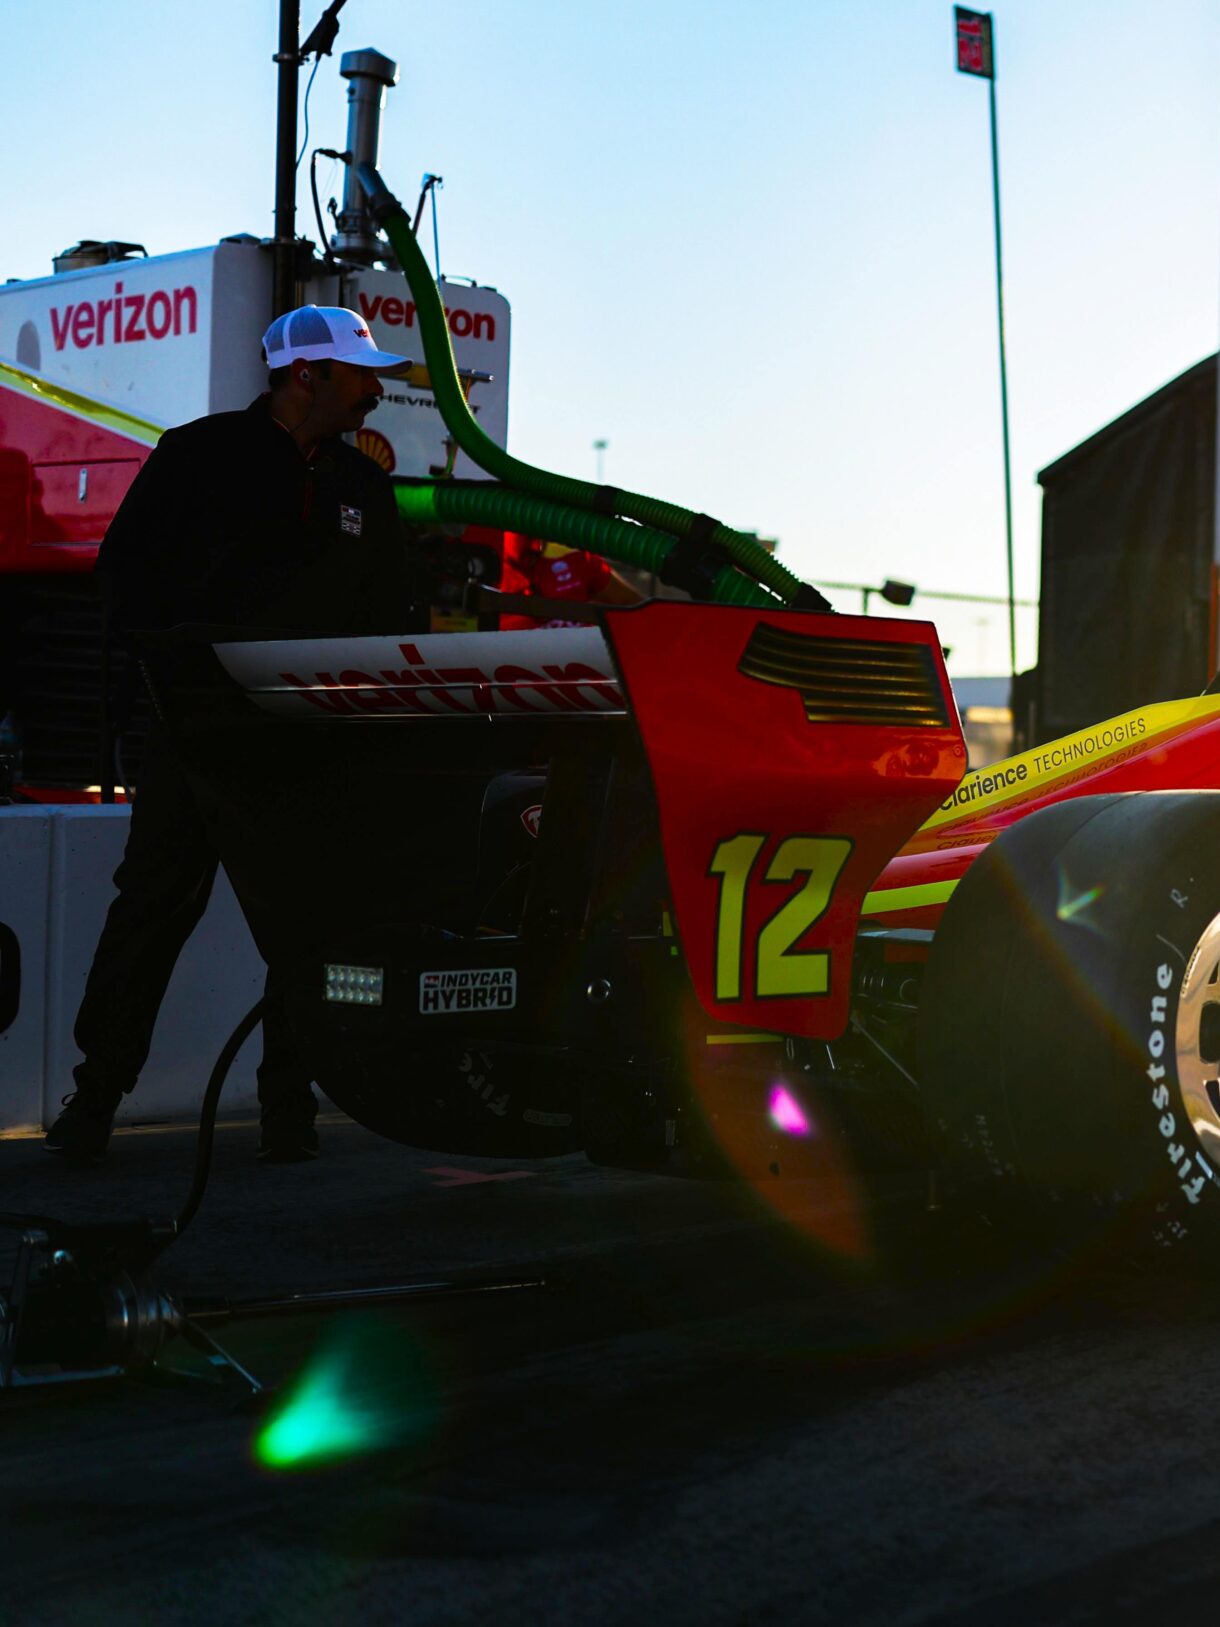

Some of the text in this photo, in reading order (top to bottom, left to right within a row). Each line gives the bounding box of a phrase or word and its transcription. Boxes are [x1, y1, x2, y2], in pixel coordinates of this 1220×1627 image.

[50, 282, 197, 351] verizon
[358, 293, 496, 342] veron
[279, 643, 628, 714] verizon
[1034, 717, 1147, 774] TECHNOLOGIES
[706, 829, 856, 1004] 12
[441, 971, 513, 988] INDYCAR
[1145, 963, 1206, 1205] Firestone
